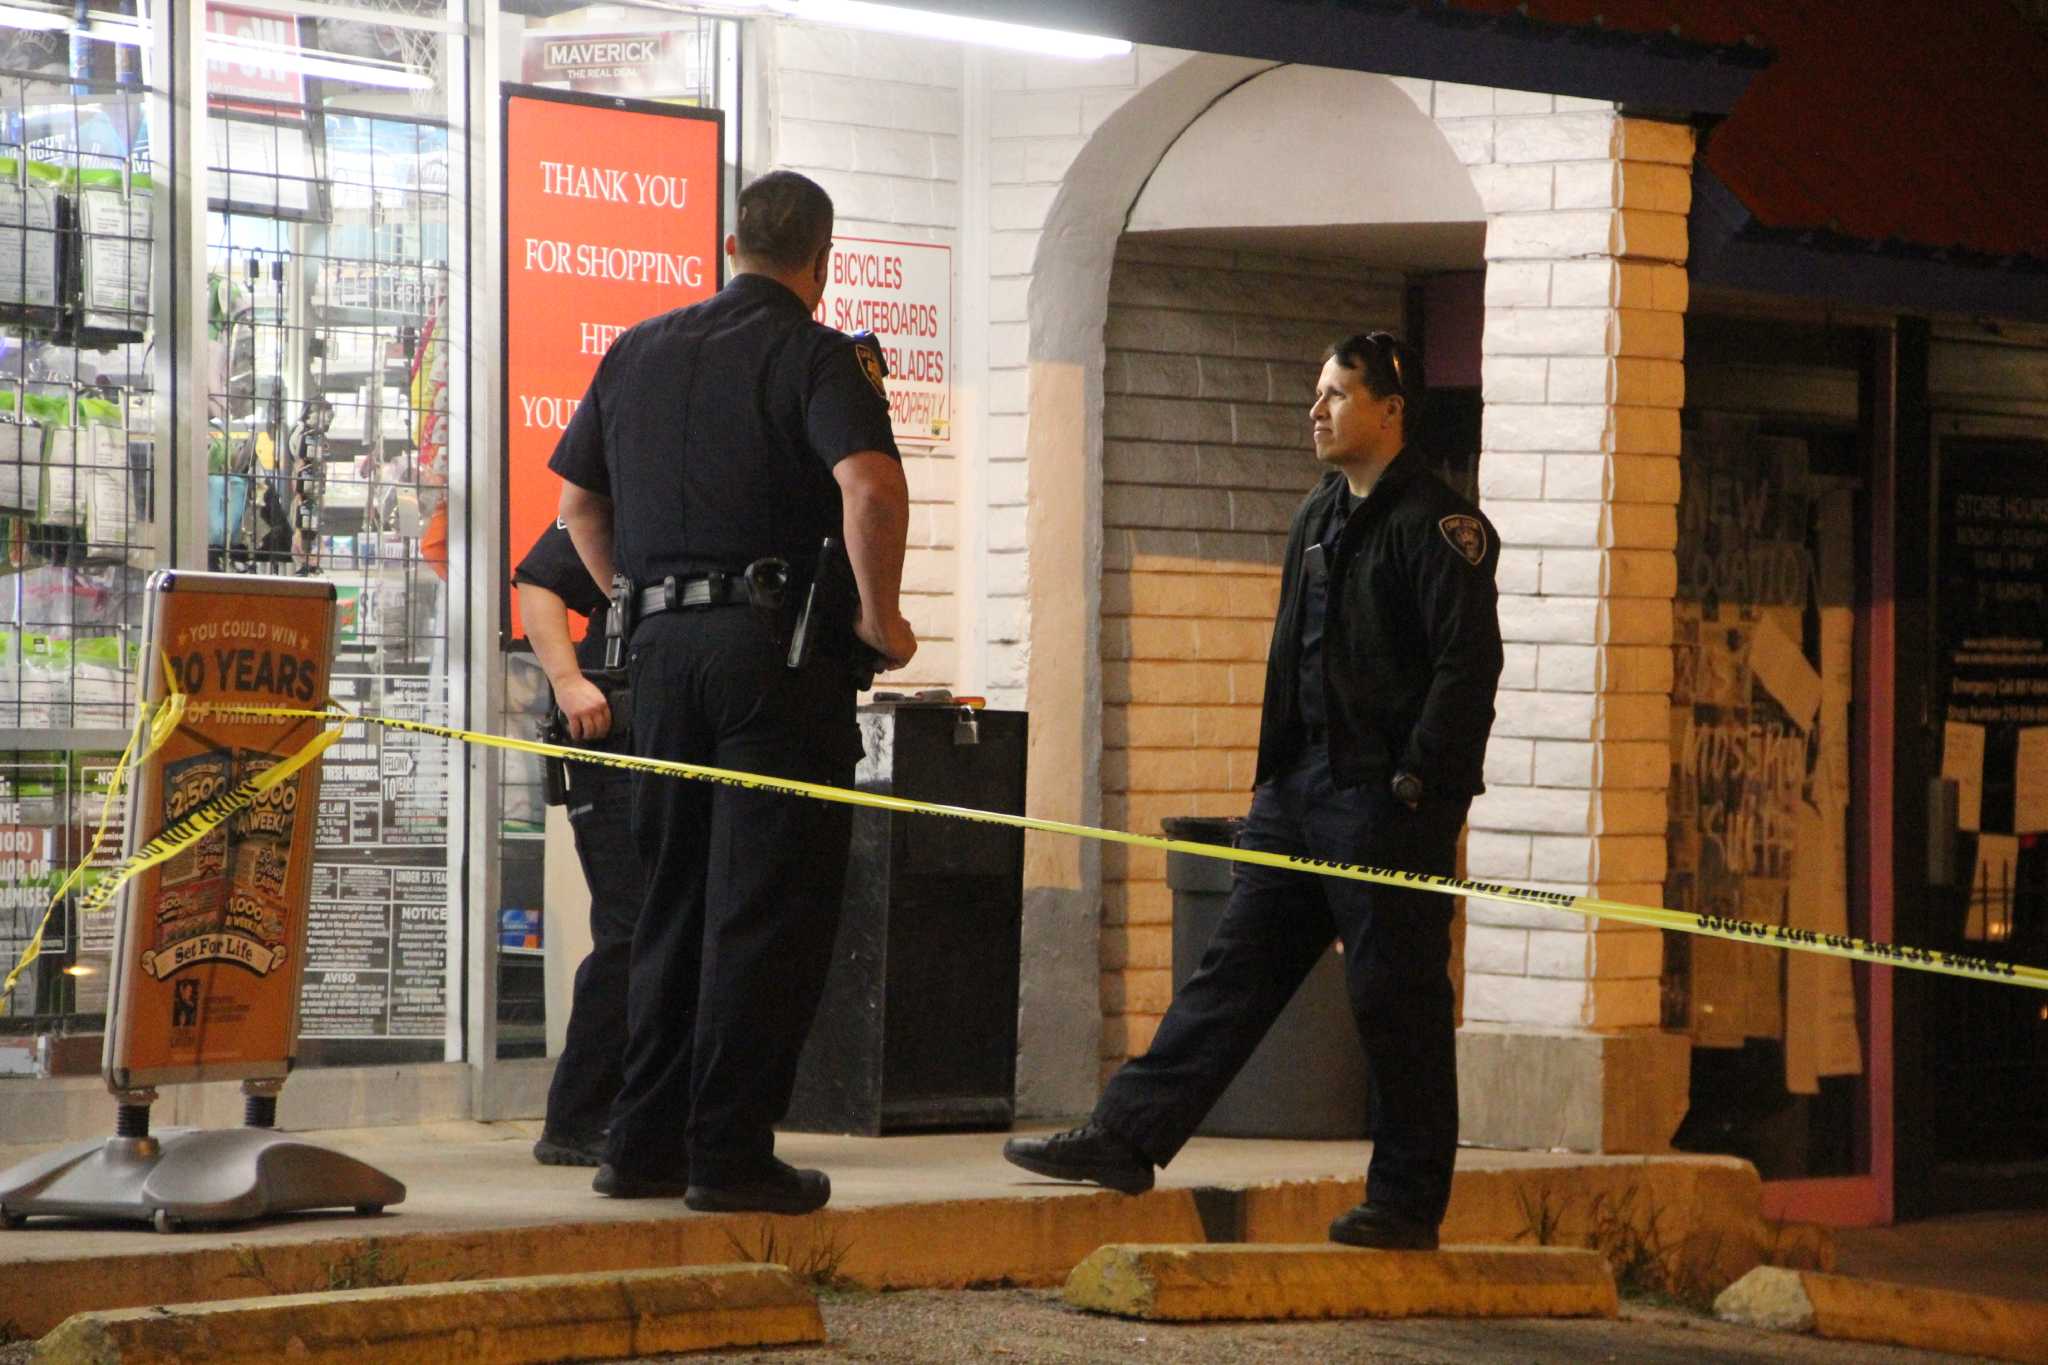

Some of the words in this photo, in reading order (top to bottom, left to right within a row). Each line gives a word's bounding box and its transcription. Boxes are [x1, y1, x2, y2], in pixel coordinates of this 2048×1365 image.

[551, 42, 655, 65] MAVERICK
[567, 69, 585, 79] THE
[588, 68, 611, 78] REAL
[540, 160, 629, 203] THANK
[634, 172, 688, 209] YOU
[524, 238, 572, 275] FOR
[576, 244, 703, 287] SHOPPING
[833, 252, 903, 290] BICYCLES
[834, 297, 938, 338] SKATEBOARDS
[519, 394, 582, 430] YOU
[888, 390, 946, 425] PROPERTY
[189, 622, 218, 642] YOU
[222, 620, 267, 639] COULD
[271, 624, 298, 646] WIN
[214, 648, 316, 701] YEARS
[384, 756, 409, 772] FELONY
[383, 777, 396, 801] 10
[329, 802, 346, 815] LAW
[402, 905, 448, 921] NOTICE
[175, 943, 196, 964] Set
[199, 937, 223, 956] For
[226, 938, 254, 962] Life
[323, 972, 357, 984] AVISO
